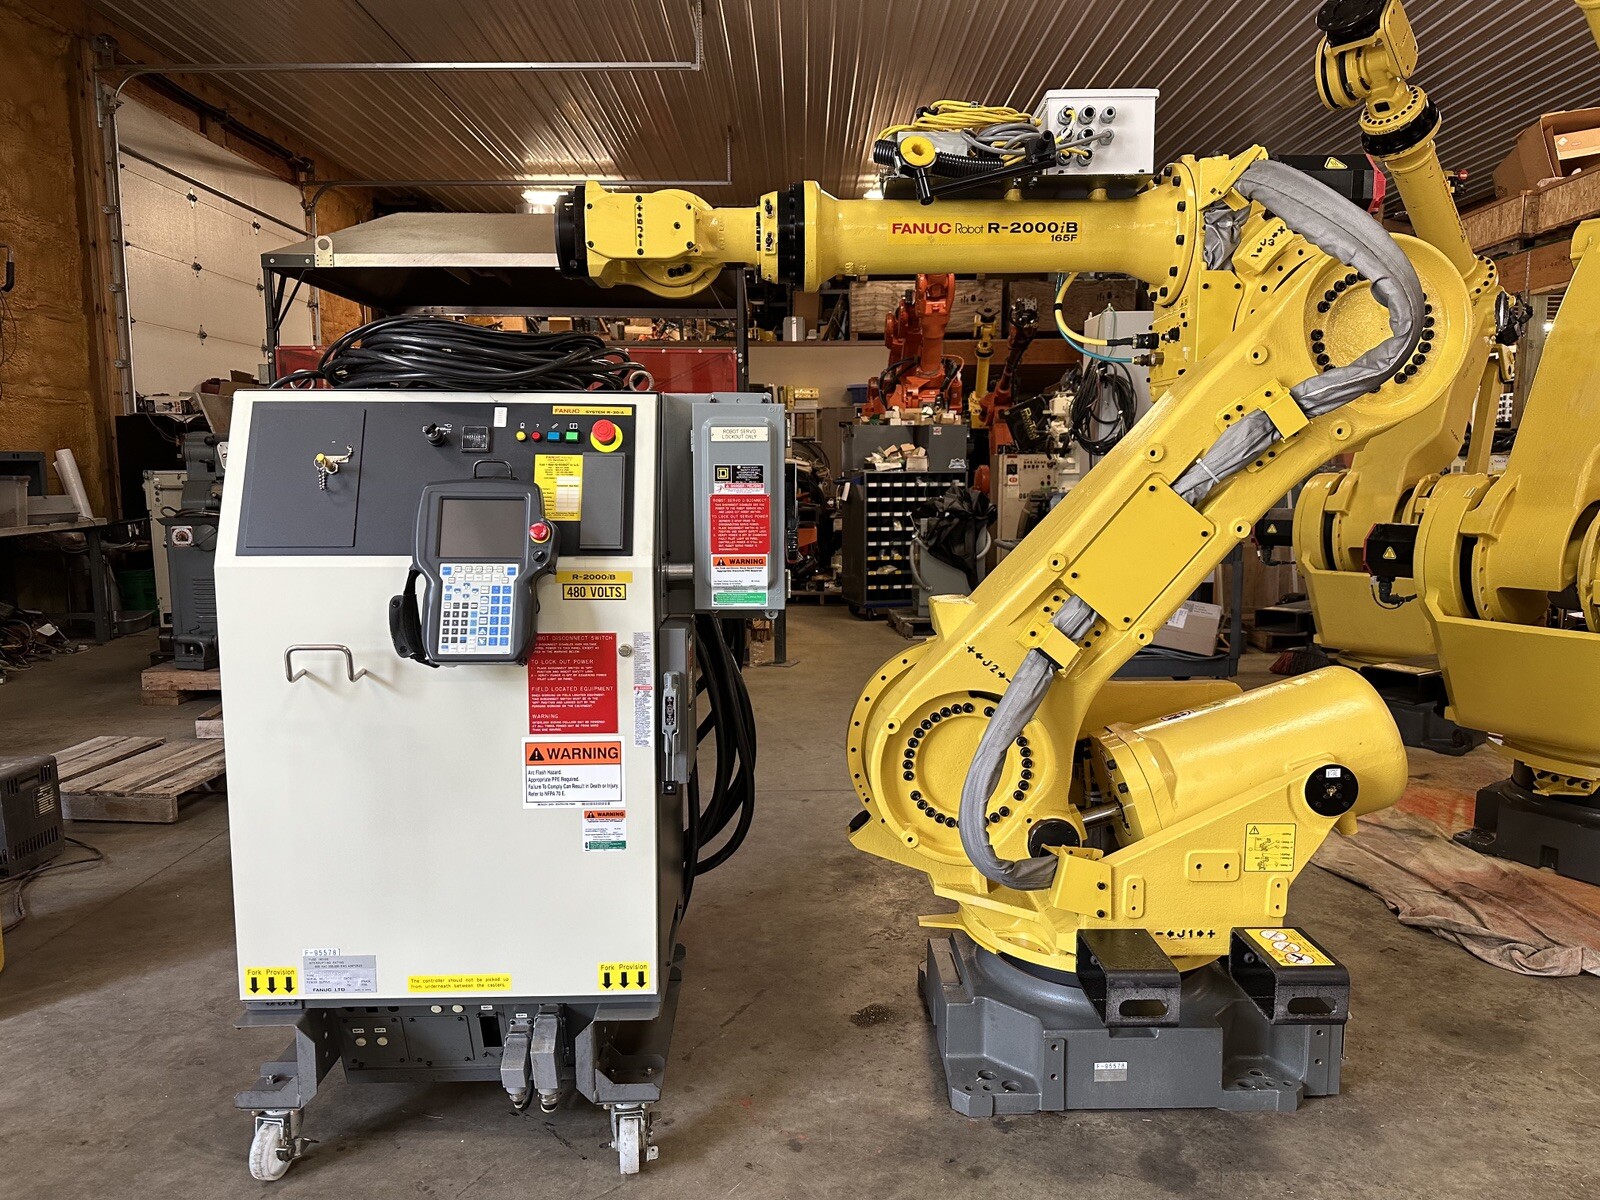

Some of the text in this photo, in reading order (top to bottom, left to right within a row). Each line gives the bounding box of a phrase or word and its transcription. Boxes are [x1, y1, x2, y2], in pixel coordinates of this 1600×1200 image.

[892, 222, 1078, 234] FANUC Robot R-2000iB
[1051, 234, 1078, 242] 165F
[1260, 238, 1275, 246] J3
[566, 586, 622, 598] 480 VOLTS
[982, 659, 999, 674] J2
[547, 747, 619, 760] WARNING
[1177, 930, 1193, 938] J1
